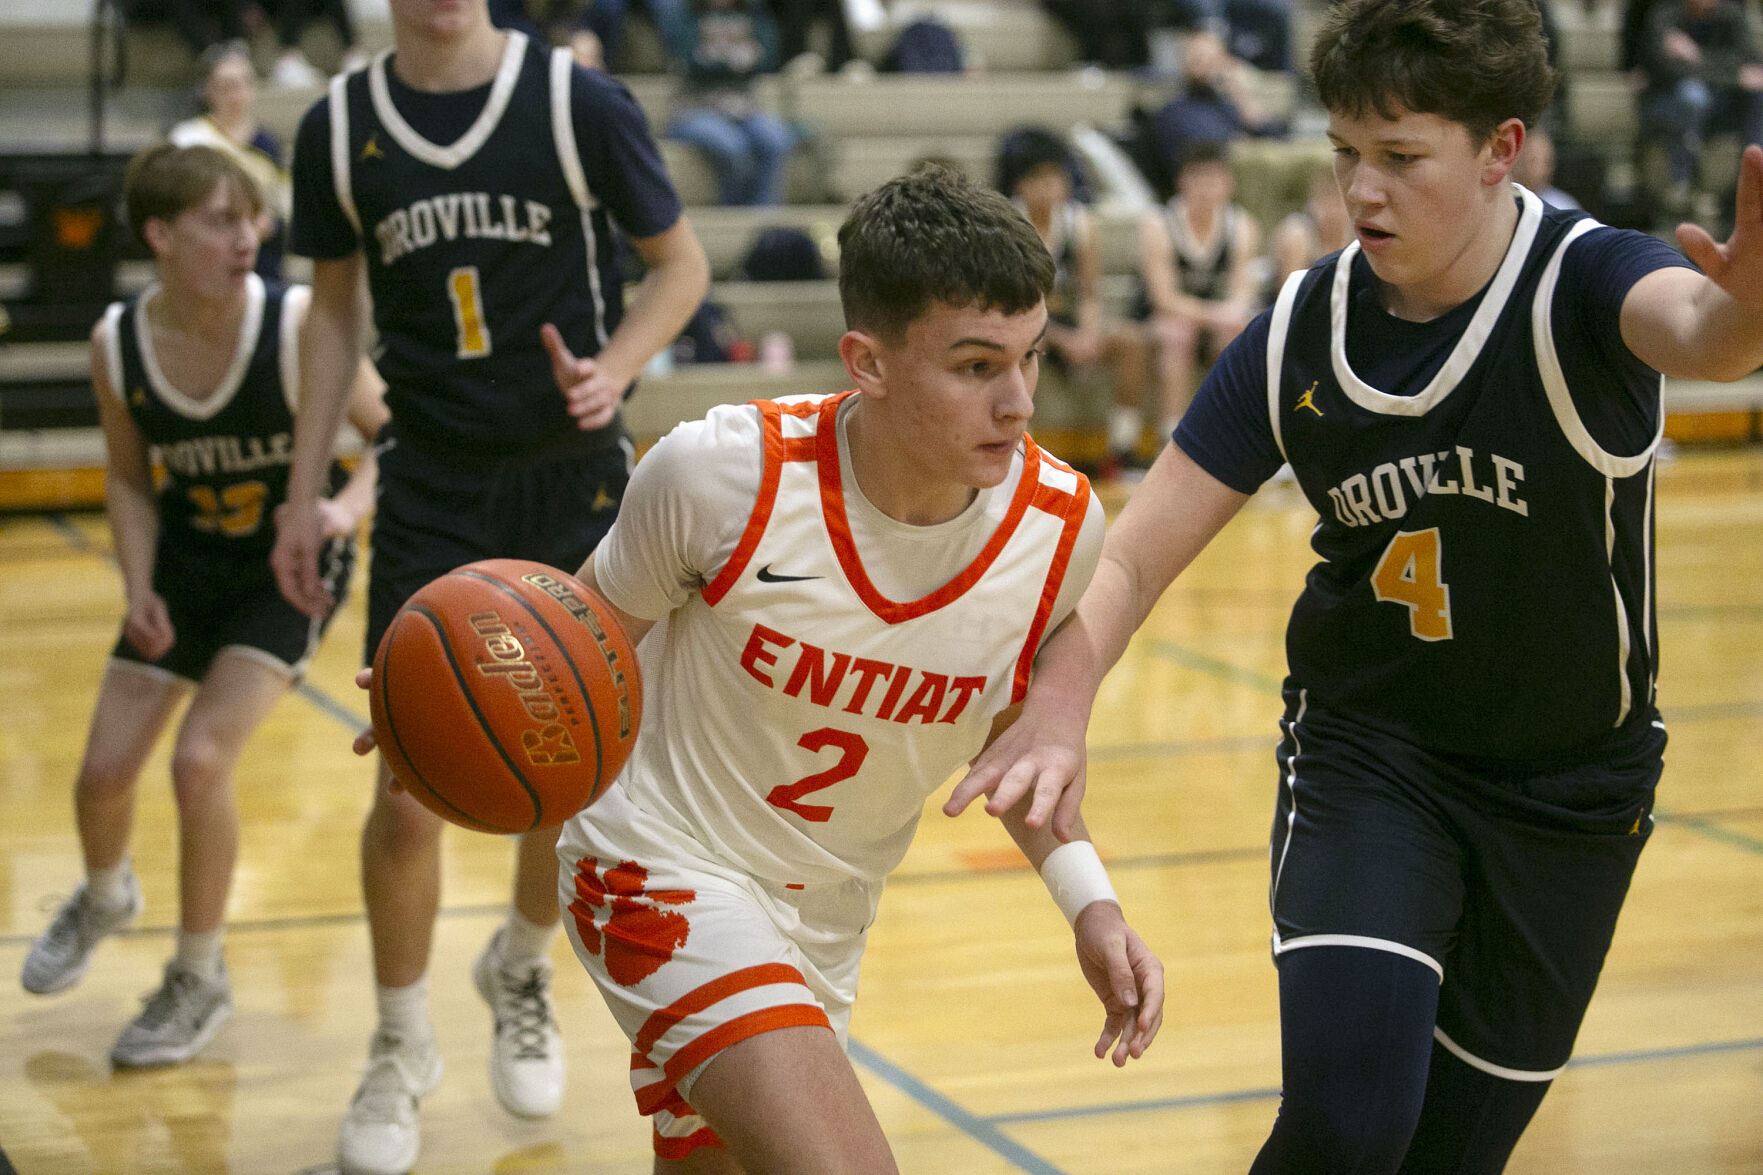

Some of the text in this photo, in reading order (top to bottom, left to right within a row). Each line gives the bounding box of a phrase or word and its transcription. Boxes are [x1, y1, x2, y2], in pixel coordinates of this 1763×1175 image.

[447, 265, 492, 360] 1
[1370, 527, 1454, 642] 4
[469, 611, 581, 765] Baden
[740, 623, 987, 725] ENTIAT
[766, 727, 869, 822] 2
